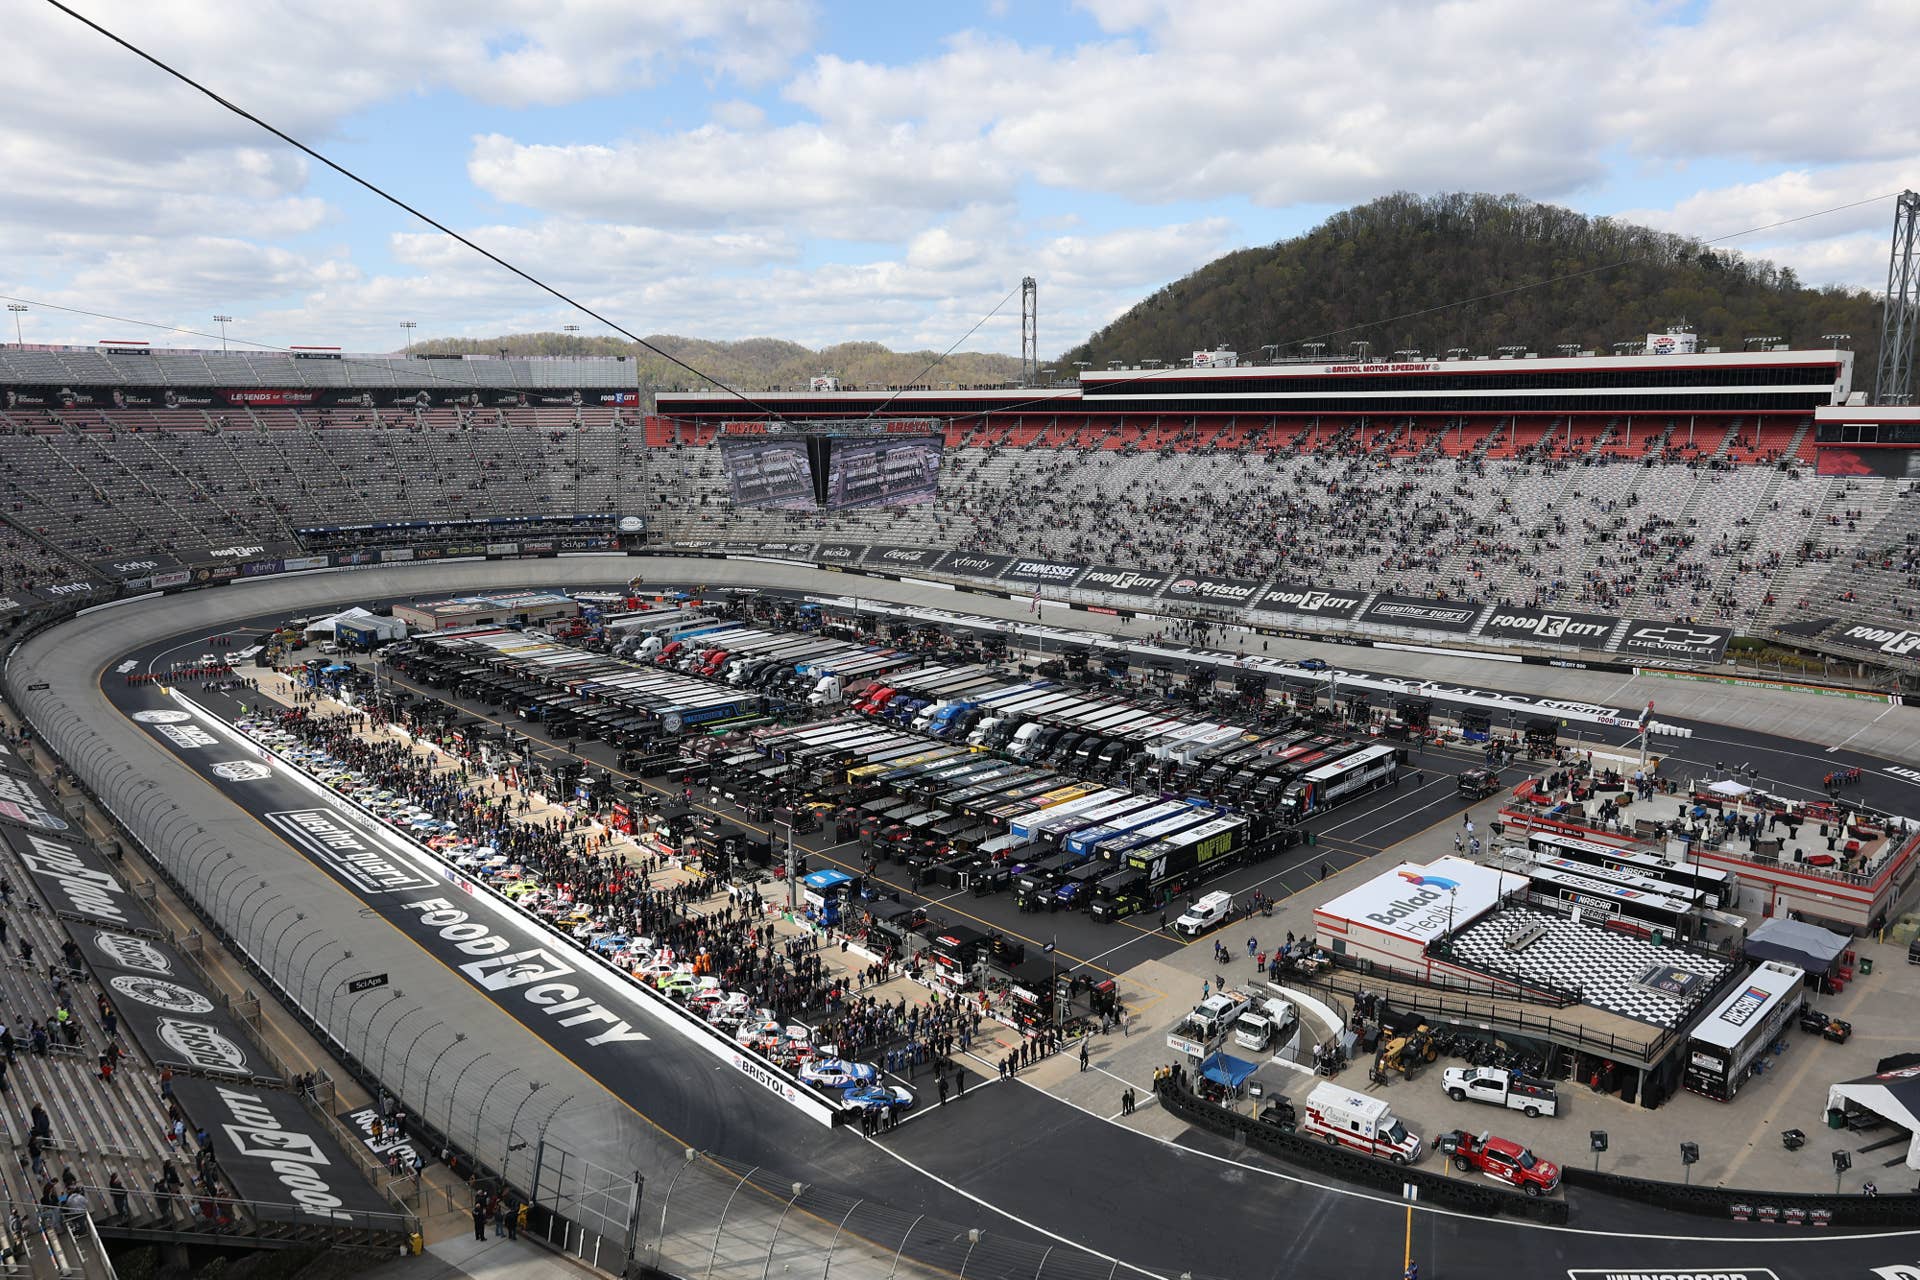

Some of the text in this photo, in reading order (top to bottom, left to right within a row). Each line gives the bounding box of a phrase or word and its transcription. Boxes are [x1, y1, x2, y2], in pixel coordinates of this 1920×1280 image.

[1332, 363, 1431, 373] BRISTOL MOTOR SPEEDWAY
[726, 422, 767, 434] BRISTOL
[886, 421, 931, 433] BRISTOL
[210, 545, 264, 557] FOOD CITY
[561, 539, 587, 549] SciAps
[113, 559, 158, 573] SciAps
[252, 561, 277, 574] xfinity
[951, 556, 994, 571] xfinity
[1015, 562, 1079, 577] TENNESSEE
[1086, 572, 1162, 588] FOOD CITY
[48, 581, 92, 596] xfinity
[1198, 580, 1256, 597] Bristol
[1264, 591, 1359, 609] FOOD CITY
[1379, 603, 1468, 622] weather guard
[1490, 614, 1609, 637] FOOD CITY
[1844, 625, 1896, 643] FOOD
[1627, 639, 1717, 655] CHEVROLET
[1734, 679, 1764, 689] RESTART
[1765, 683, 1783, 691] ZONE
[1790, 686, 1880, 702] EchoPark EchoPark EchoPark
[1597, 716, 1635, 727] FOOD CITY
[288, 812, 366, 850] weather
[346, 852, 422, 889] guard
[1197, 831, 1233, 863] RAPTOR
[1150, 855, 1167, 880] 24
[1366, 887, 1442, 926] Ballad
[1579, 895, 1612, 911] NASCAR
[1396, 903, 1464, 937] Health
[401, 898, 651, 1047] FOOD CITY
[355, 978, 382, 989] SciAps
[1722, 995, 1763, 1026] NASCAR
[168, 1020, 234, 1071] BUSH'S
[1171, 1039, 1200, 1054] FOOD CITY
[741, 1060, 786, 1097] BRISTOL
[832, 1075, 845, 1085] 17
[215, 1086, 282, 1134] CITY
[1503, 1168, 1513, 1179] 3
[271, 1160, 353, 1221] FOOD
